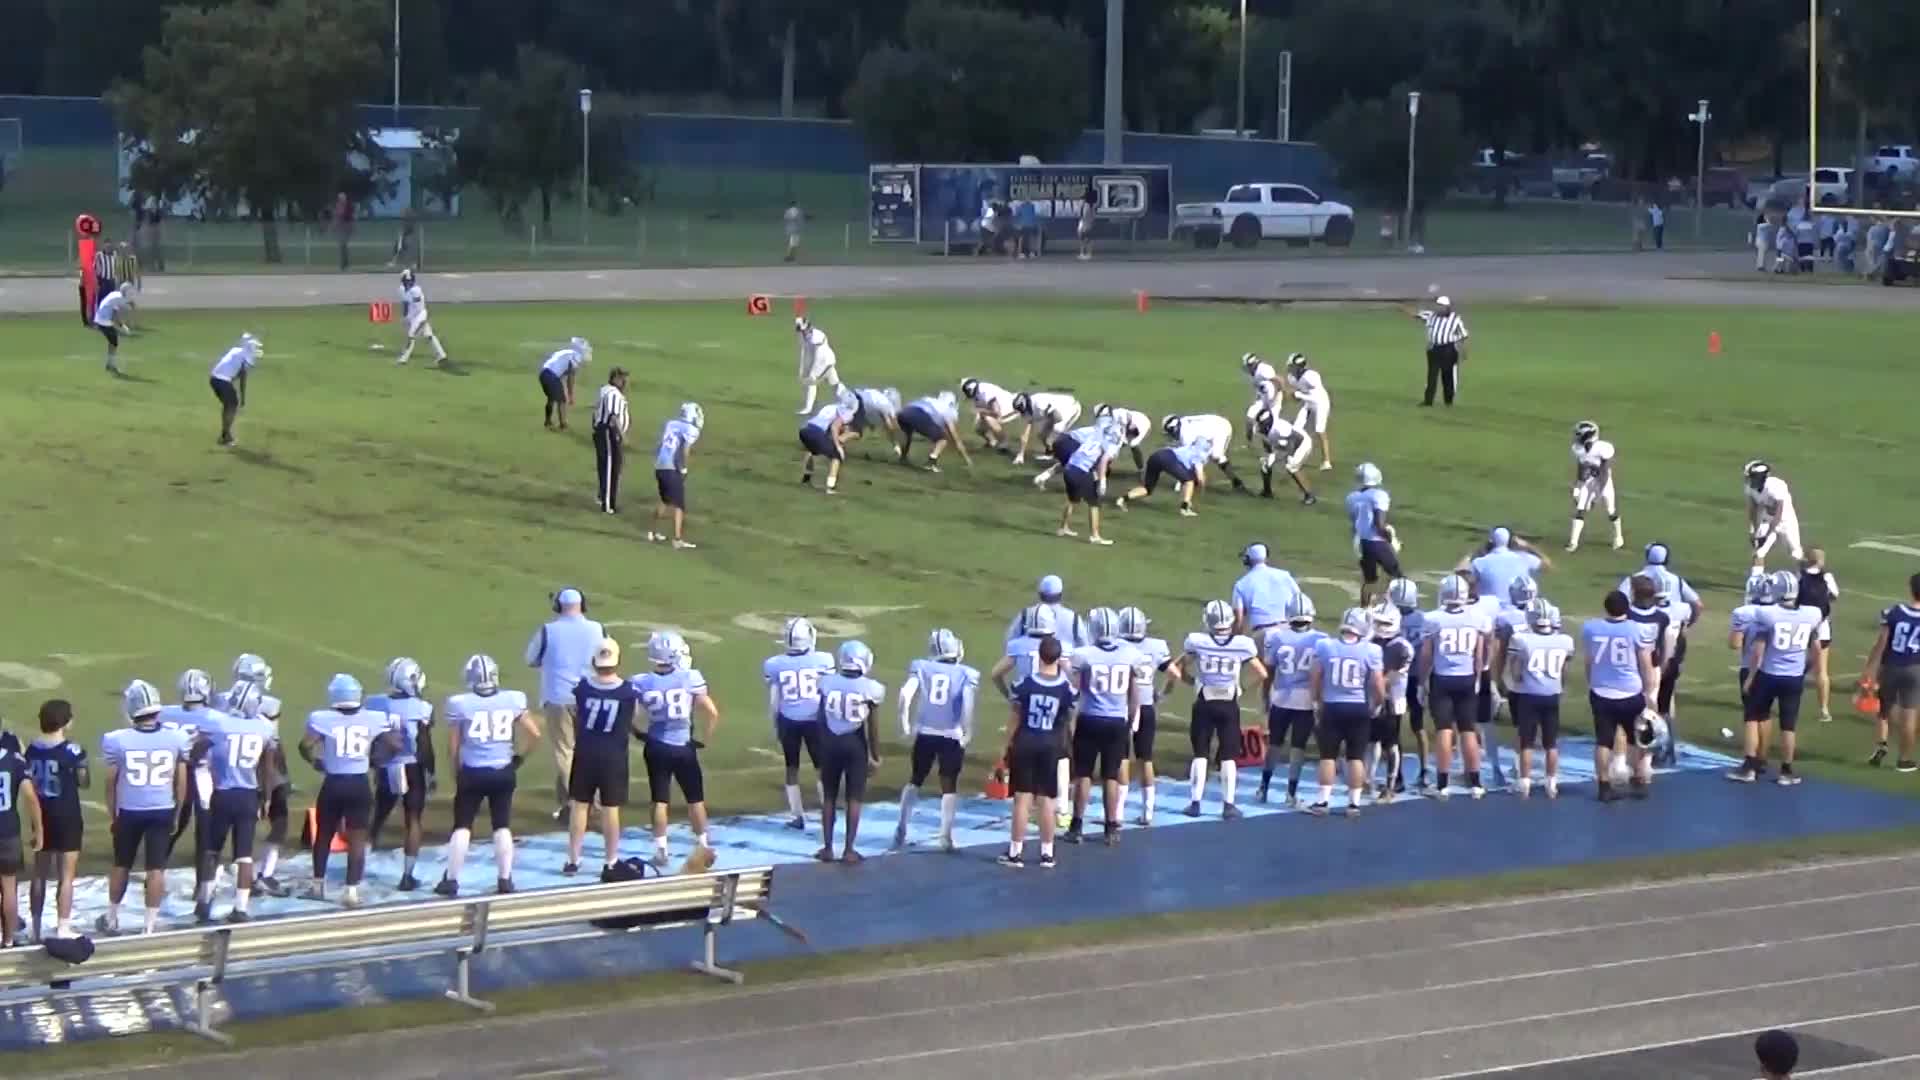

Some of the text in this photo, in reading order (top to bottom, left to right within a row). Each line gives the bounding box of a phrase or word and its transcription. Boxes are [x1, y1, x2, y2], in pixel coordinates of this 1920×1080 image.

[753, 297, 767, 311] G
[1592, 636, 1629, 666] 76
[1773, 623, 1812, 650] 64
[1277, 645, 1313, 675] 34
[1329, 657, 1363, 689] 10
[1527, 648, 1567, 679] 40
[778, 669, 822, 701] 26
[929, 673, 951, 706] 8
[1090, 664, 1130, 695] 60
[586, 697, 620, 732] 77
[643, 689, 692, 719] 28
[825, 689, 866, 722] 46
[332, 724, 369, 759] 16
[468, 710, 514, 743] 48
[227, 733, 264, 769] 19
[125, 749, 174, 787] 52
